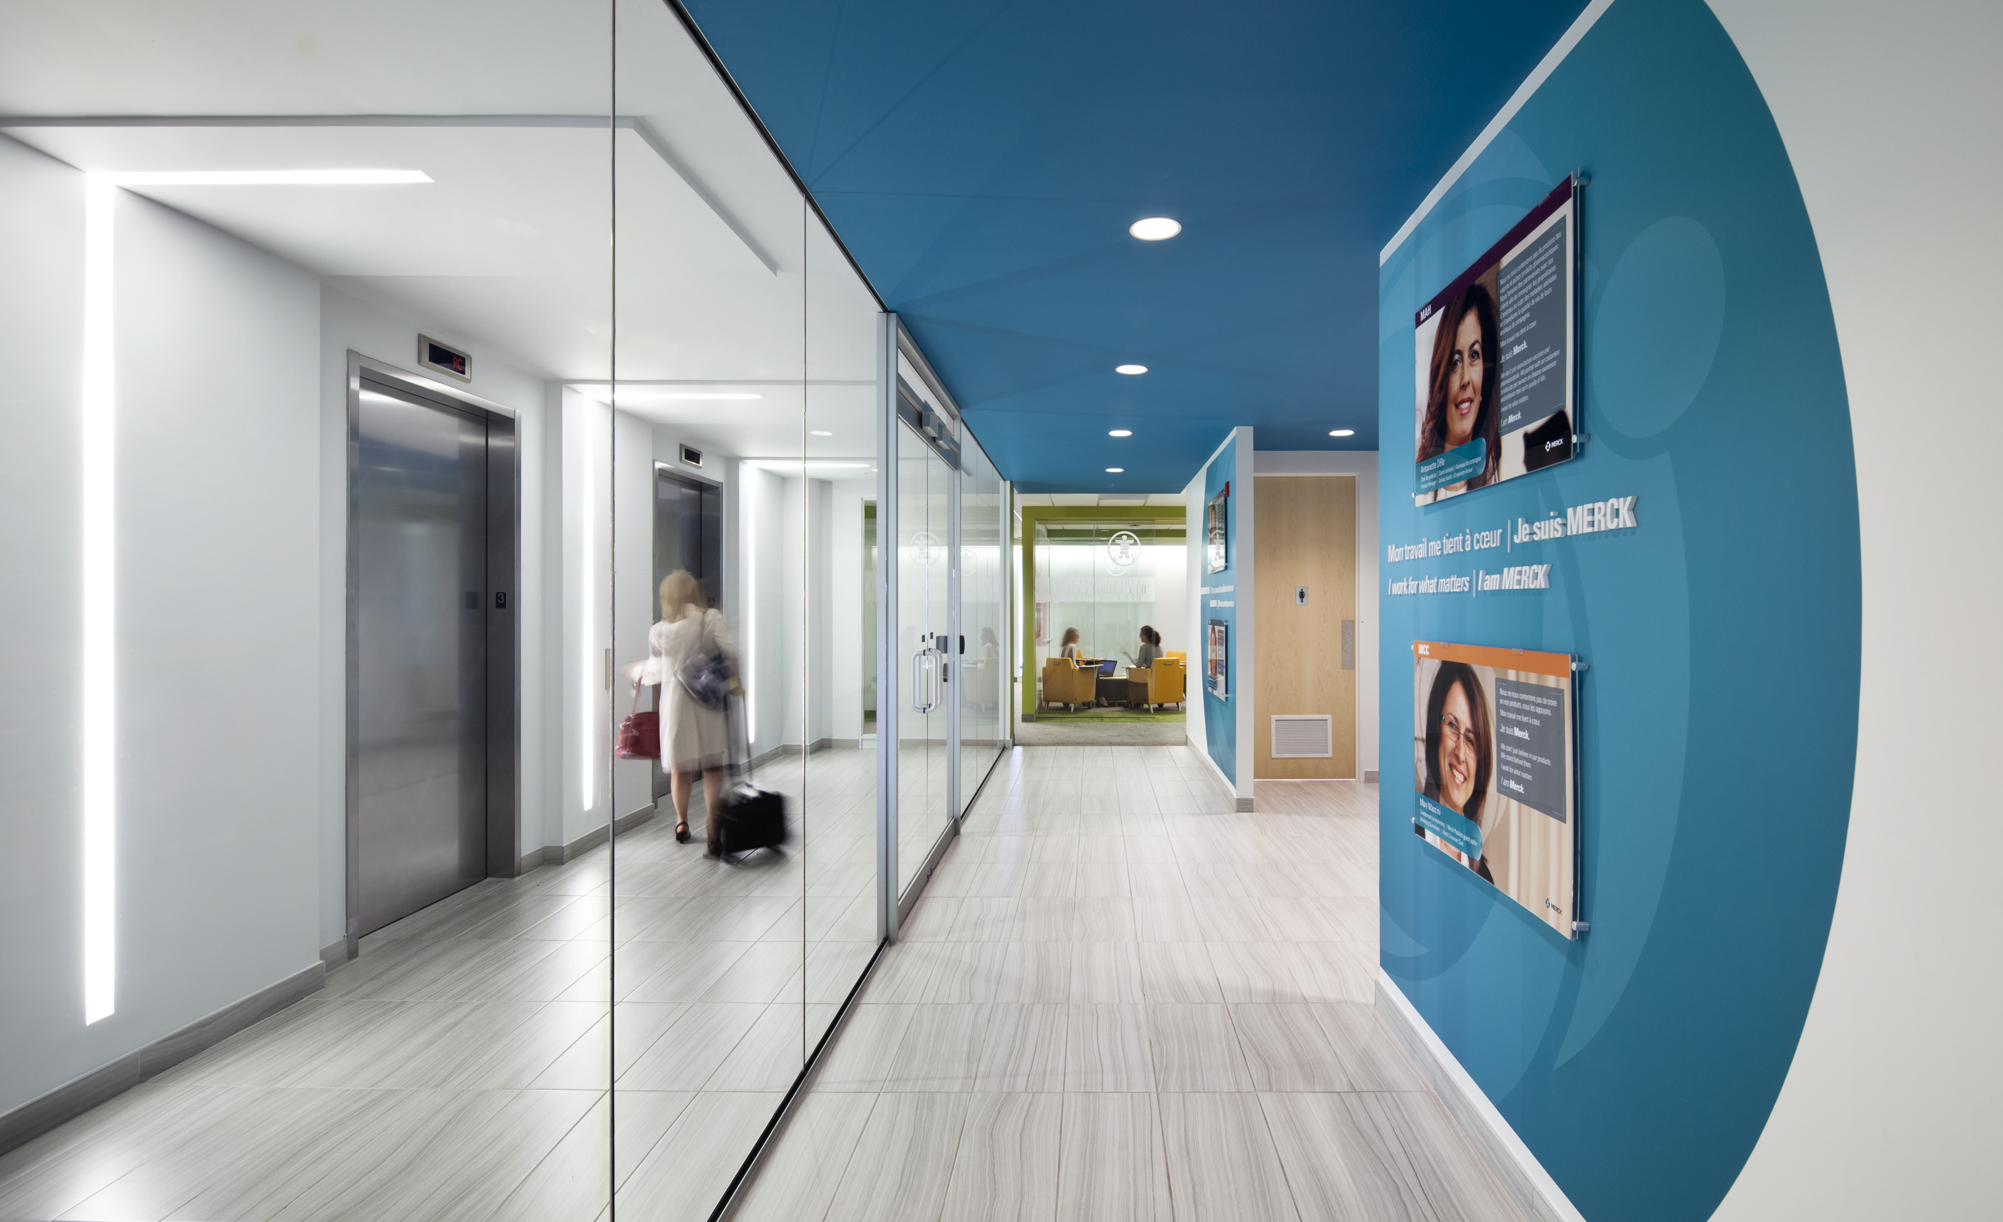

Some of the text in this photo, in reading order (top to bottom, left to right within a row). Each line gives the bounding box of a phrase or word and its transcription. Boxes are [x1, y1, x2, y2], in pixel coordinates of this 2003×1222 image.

[1388, 495, 1638, 563] Mon travail me tient à cœur Je suis MERCK
[1392, 577, 1408, 595] work
[1408, 576, 1419, 594] for
[1419, 575, 1438, 594] what
[1438, 574, 1470, 593] matters
[1478, 570, 1486, 591] I
[1483, 574, 1500, 591] am
[1501, 564, 1552, 590] MERCK
[497, 592, 505, 604] 3
[1514, 727, 1530, 740] Merck.
[1510, 780, 1524, 793] Merck.
